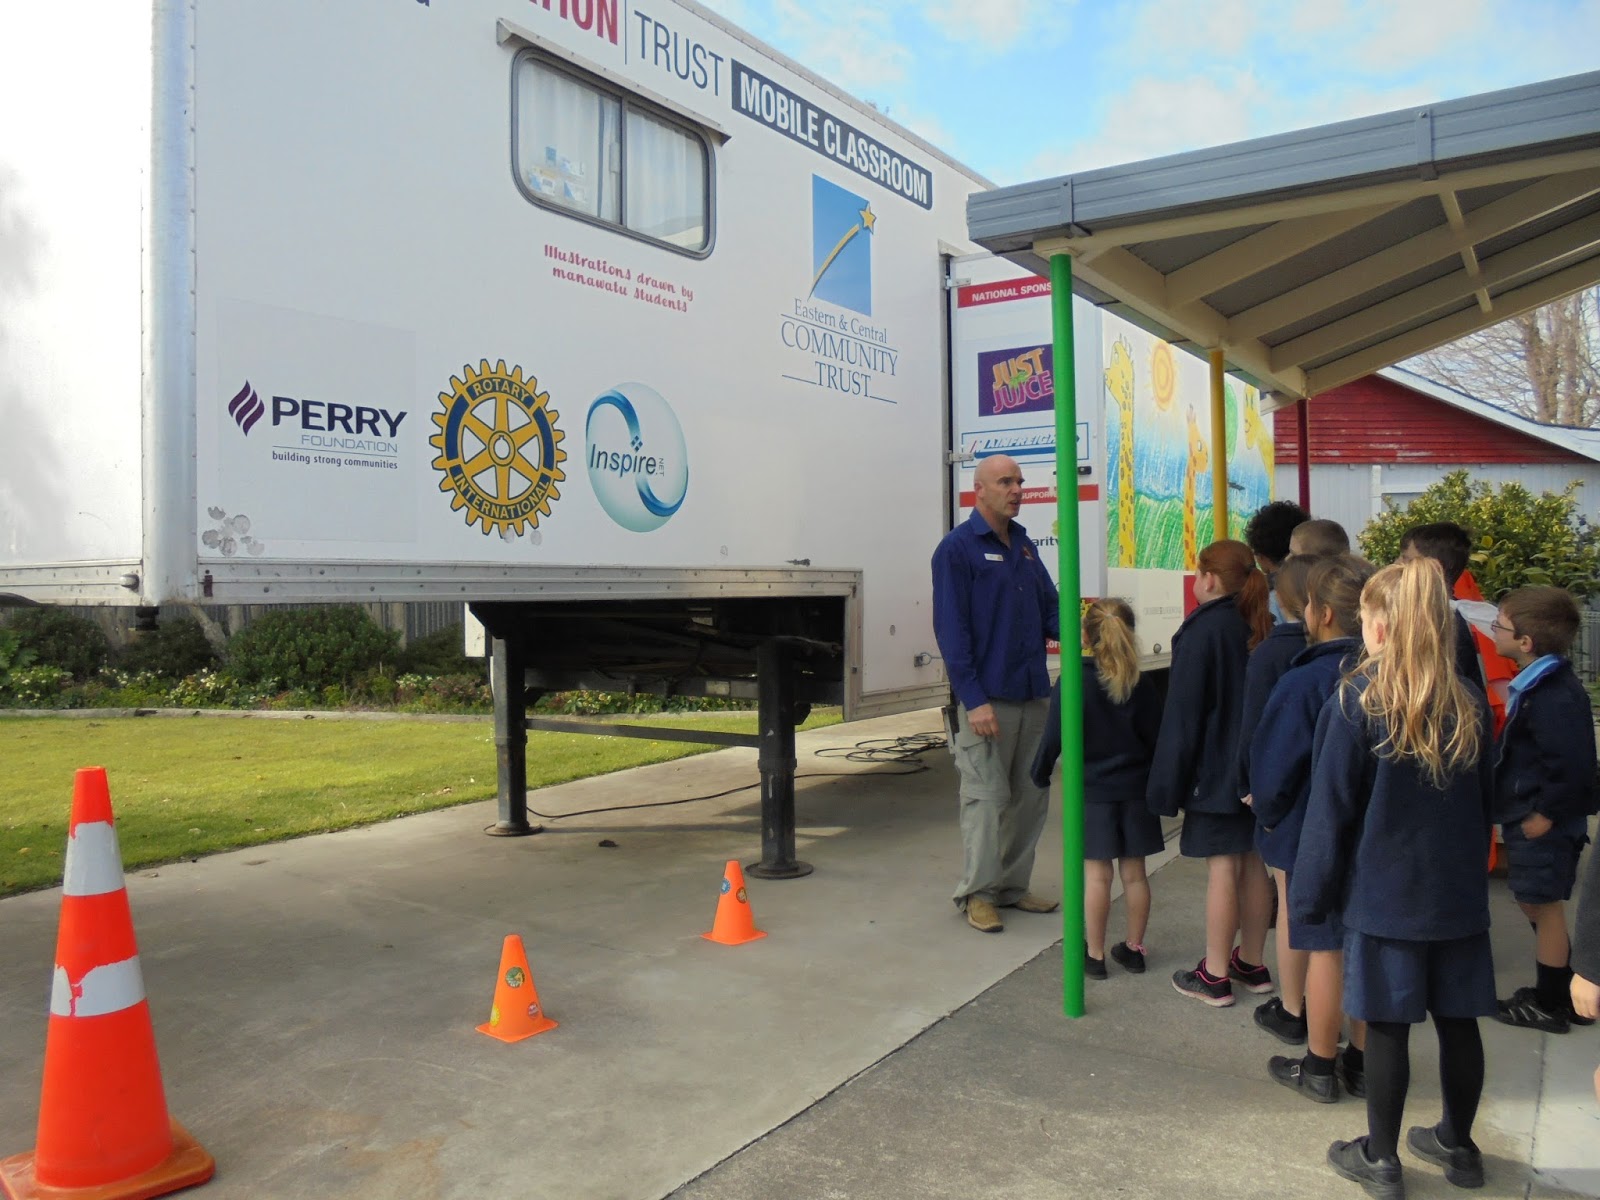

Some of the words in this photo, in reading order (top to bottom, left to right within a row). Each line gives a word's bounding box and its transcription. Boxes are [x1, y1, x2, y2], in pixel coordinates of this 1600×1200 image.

[633, 9, 725, 97] TRUST
[740, 71, 819, 147] MOBILE
[823, 118, 928, 205] CLASSROOM
[544, 244, 632, 281] Illustrations
[636, 272, 676, 294] drawn
[681, 285, 694, 302] by
[552, 266, 628, 296] manawatu
[633, 287, 688, 313] students
[971, 287, 1018, 302] NATIONAL
[1020, 281, 1052, 294] SPONS
[794, 297, 837, 328] Eastern
[838, 314, 849, 332] &
[850, 317, 888, 344] Central
[781, 320, 898, 377] COMMUNITY
[992, 347, 1044, 391] JUST
[472, 378, 531, 403] ROTARY
[814, 360, 872, 398] TRUST
[992, 369, 1055, 414] JUICE
[272, 395, 408, 438] PERRY
[272, 450, 311, 465] building
[313, 455, 342, 467] strong
[344, 459, 398, 470] communities
[301, 434, 398, 453] FOUNDATION
[969, 434, 1057, 453] MAINFREIGH
[454, 472, 550, 519] INTERNATIONAL
